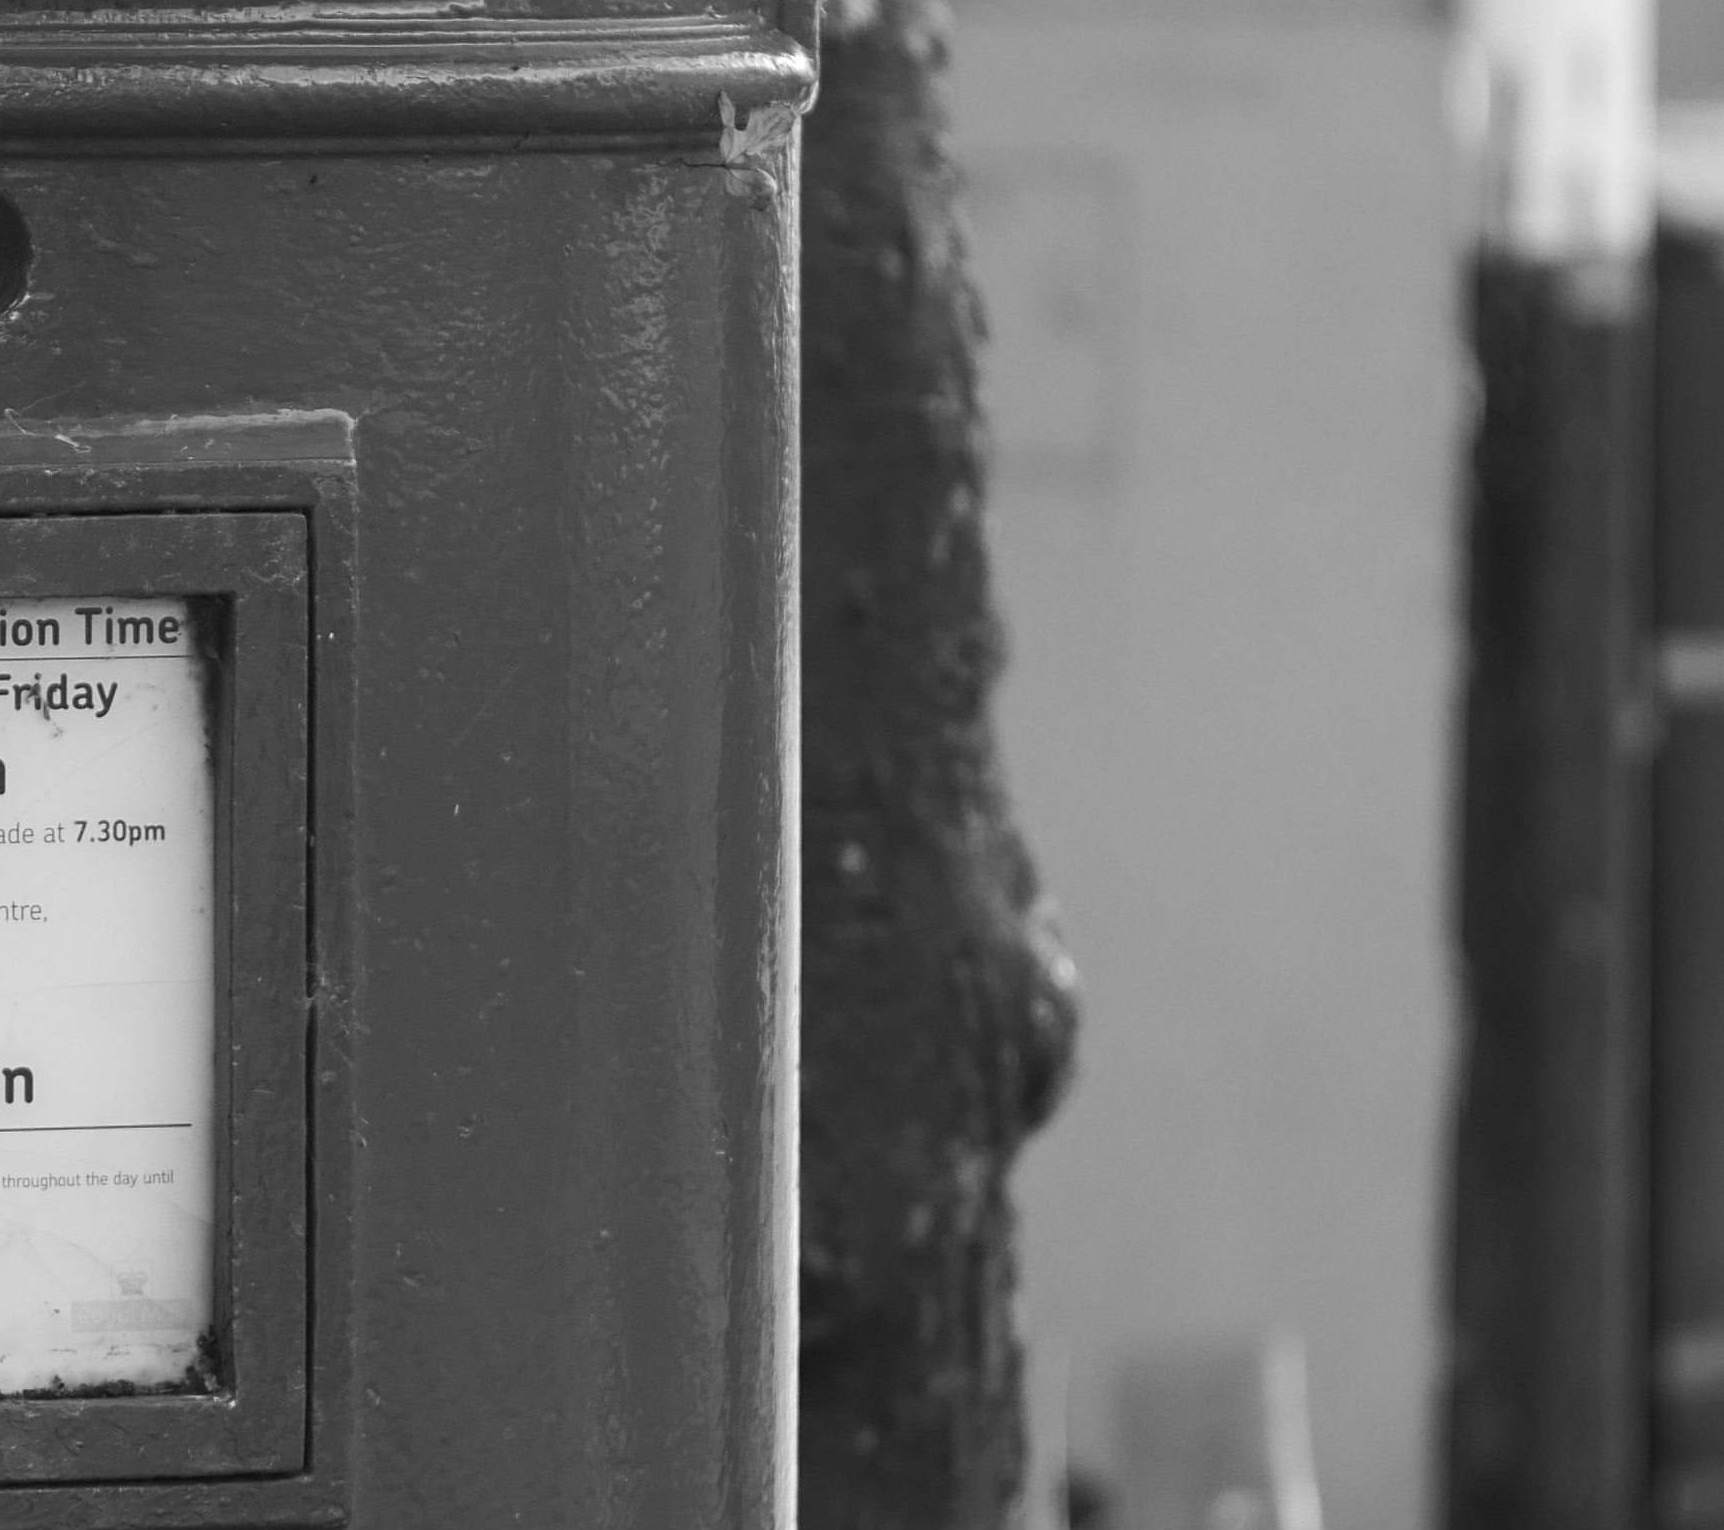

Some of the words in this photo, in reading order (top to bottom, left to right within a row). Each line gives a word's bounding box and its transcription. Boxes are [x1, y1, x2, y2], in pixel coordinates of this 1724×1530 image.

[75, 606, 179, 646] Time
[43, 823, 65, 843] at
[74, 819, 166, 846] 7.30pm
[1, 1172, 81, 1193] throughout
[86, 1171, 108, 1187] the
[113, 1171, 138, 1189] day
[143, 1169, 174, 1185] until
